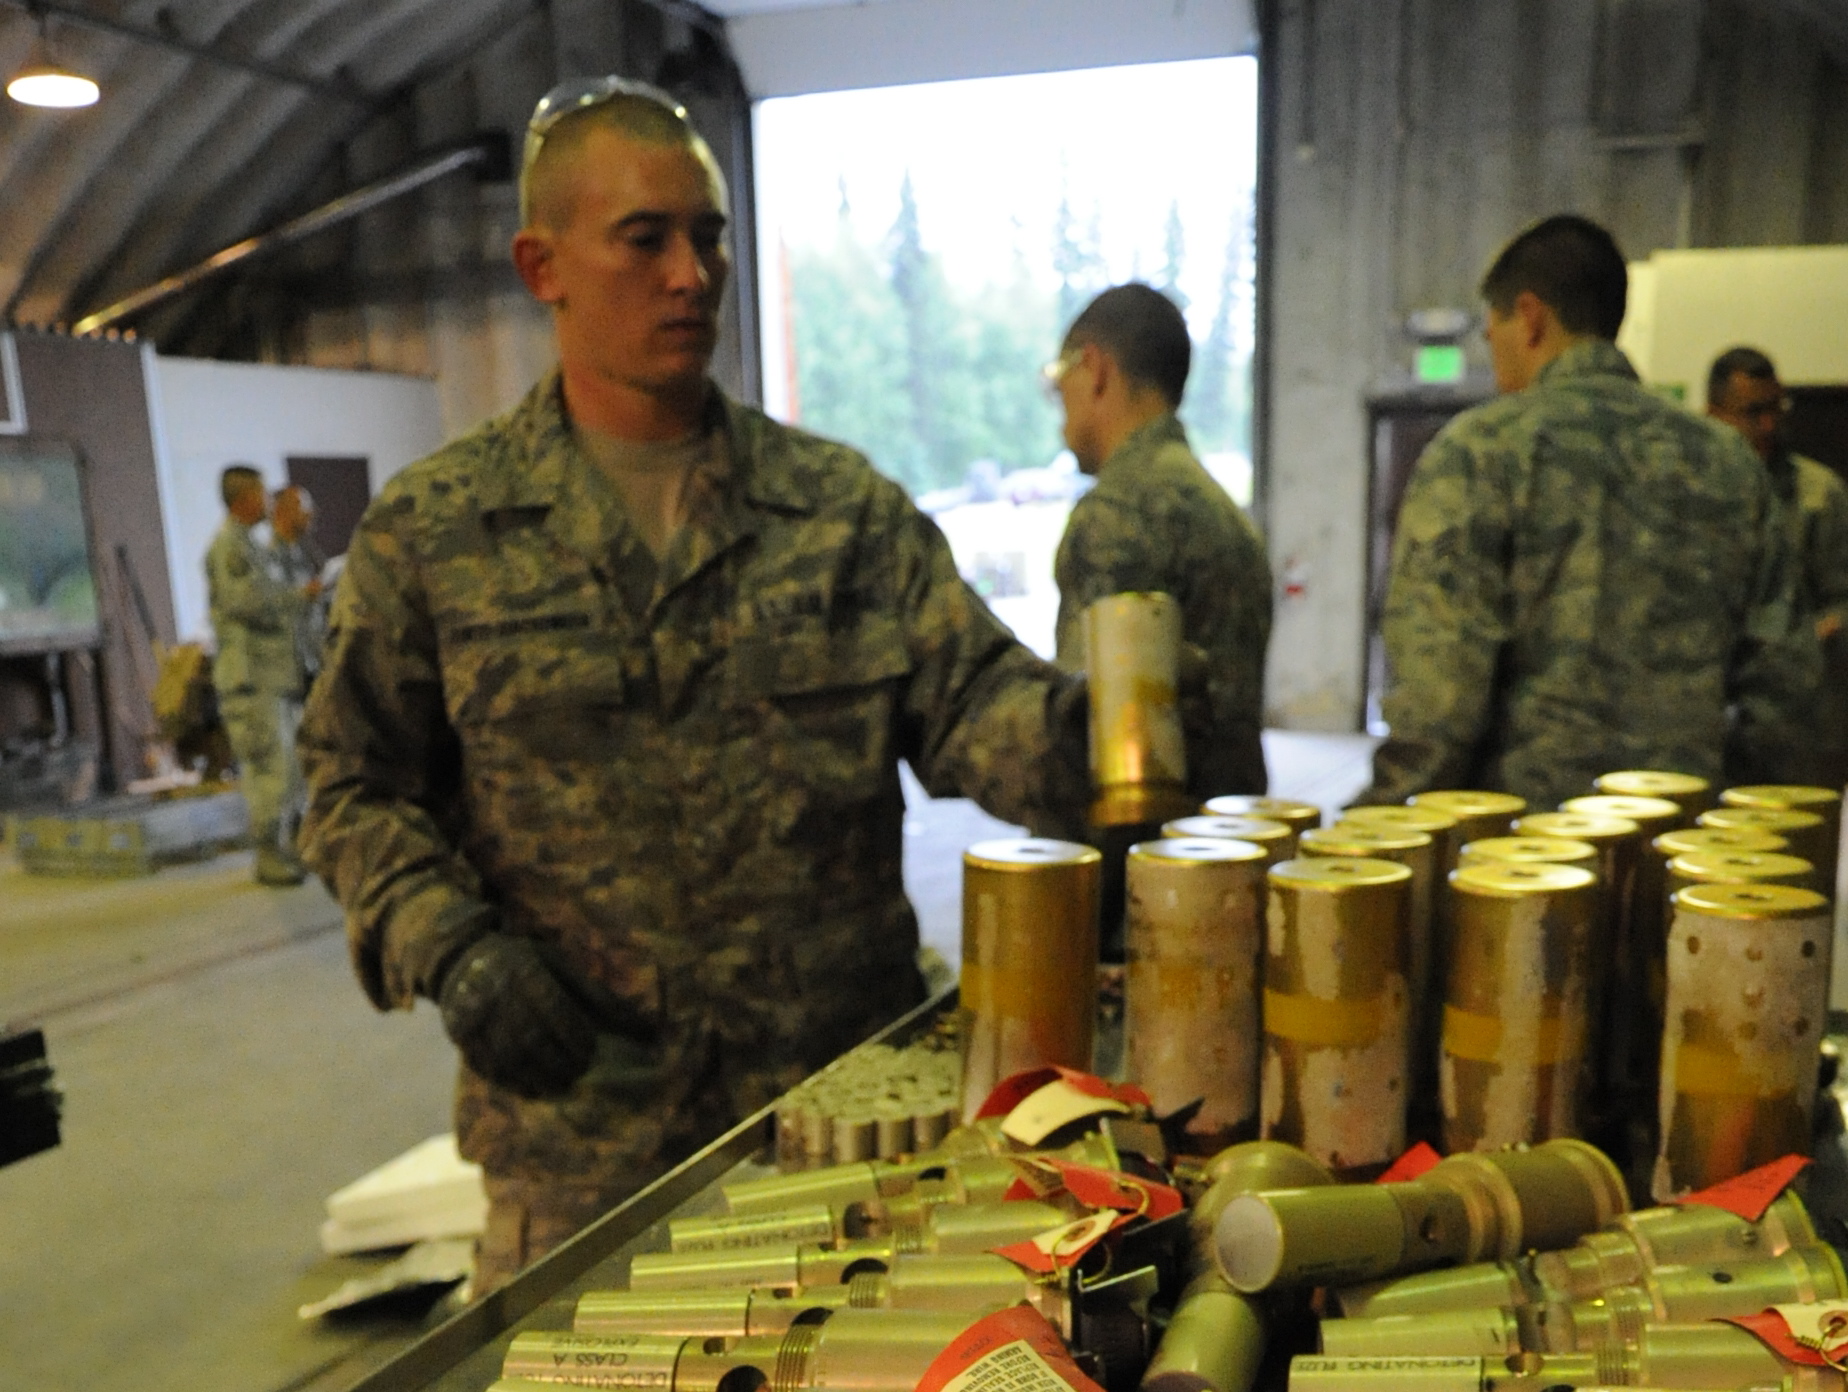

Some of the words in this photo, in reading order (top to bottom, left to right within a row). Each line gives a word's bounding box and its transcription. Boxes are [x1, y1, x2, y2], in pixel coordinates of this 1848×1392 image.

[553, 1353, 568, 1366] A
[575, 1352, 628, 1367] CLASS
[1004, 1381, 1016, 1390] IS
